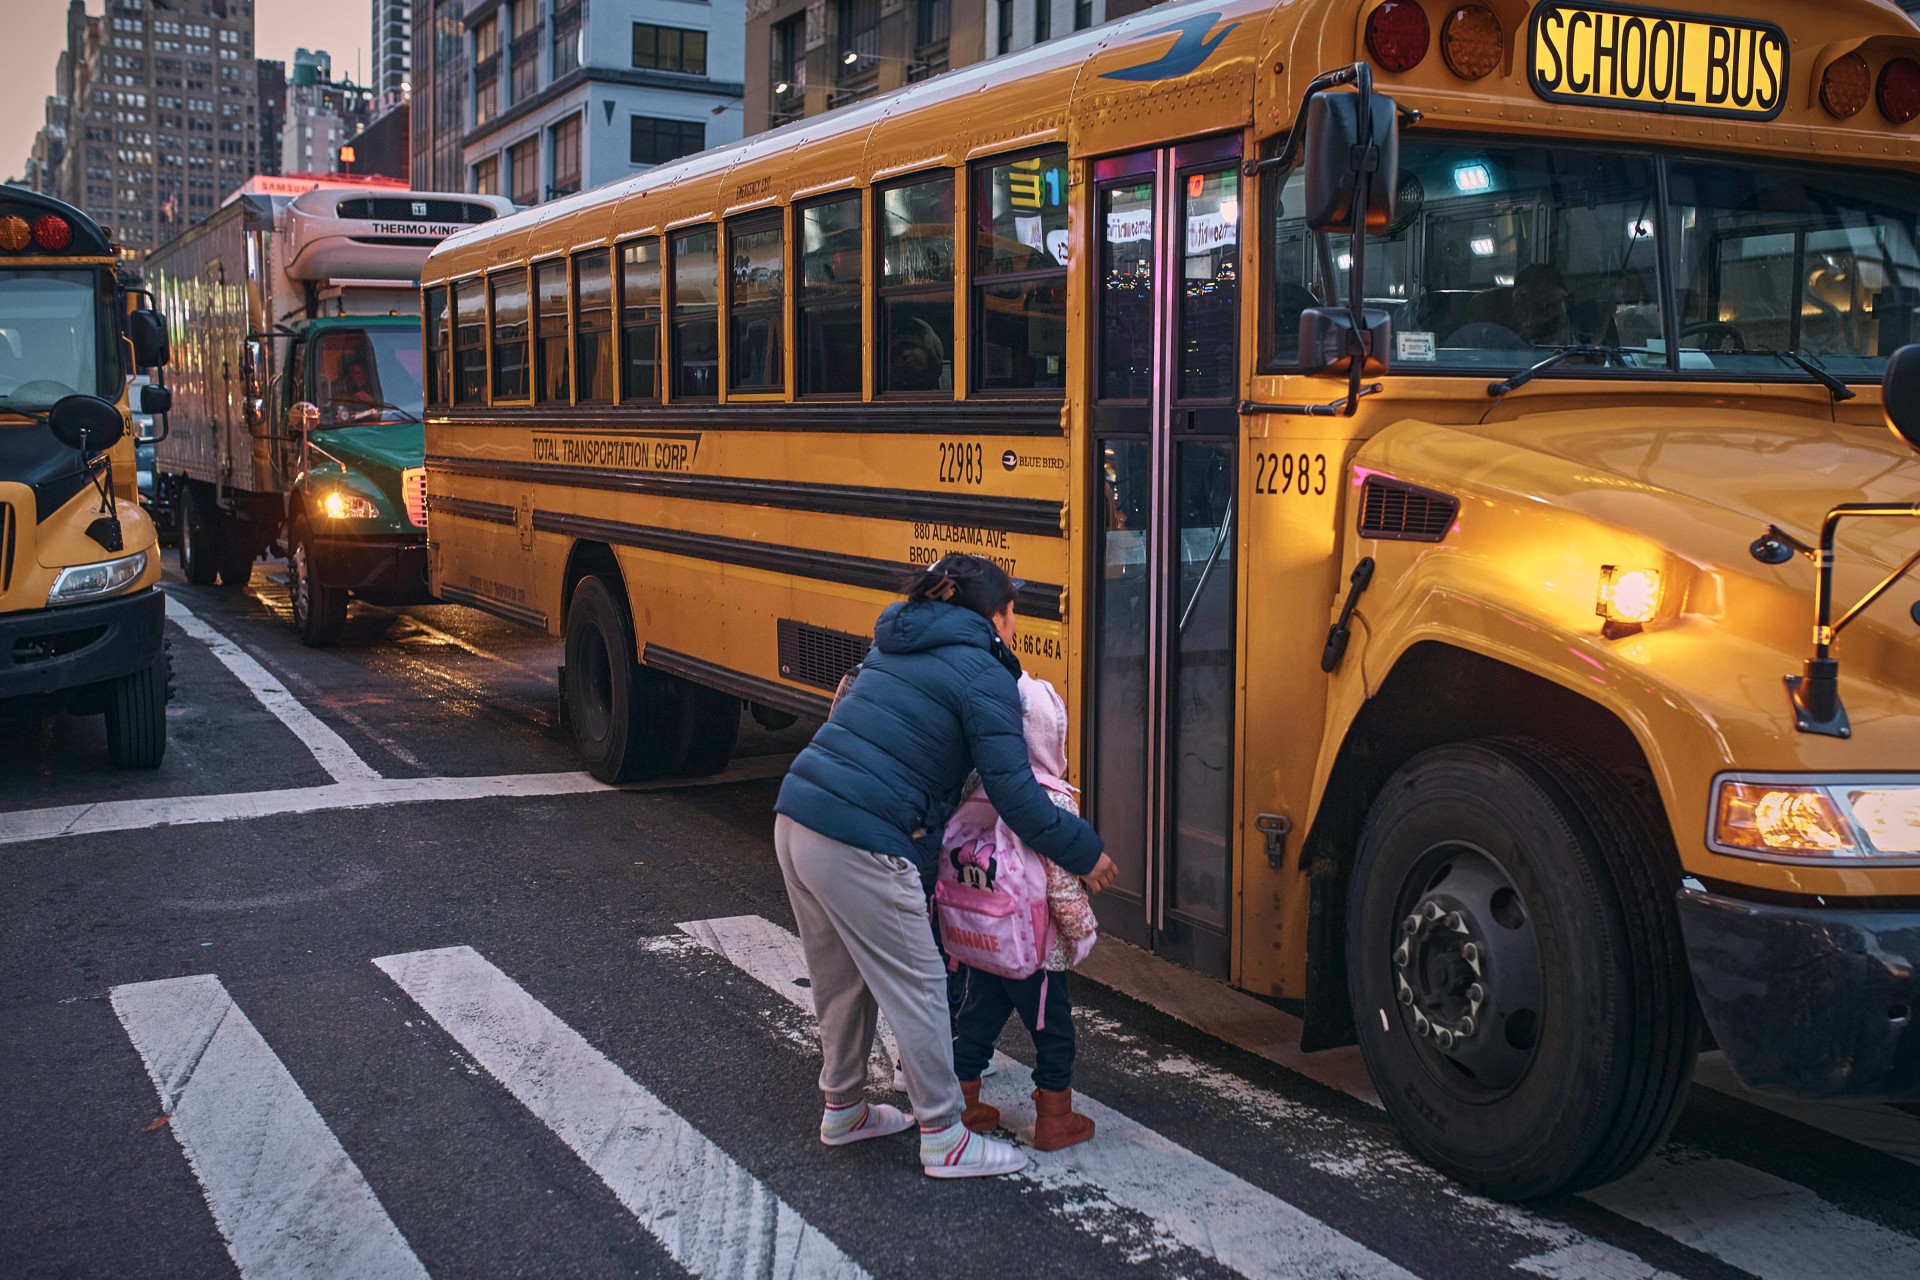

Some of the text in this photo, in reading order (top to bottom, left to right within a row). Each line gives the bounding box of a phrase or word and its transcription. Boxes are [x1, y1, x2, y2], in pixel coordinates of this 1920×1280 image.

[1537, 8, 1780, 109] SCHOOL BUS
[372, 222, 459, 236] THERMO KING
[532, 437, 690, 471] TOTAL TRANSPORTATION CORP.
[939, 442, 983, 485] 22983
[1018, 456, 1065, 469] BLUE BIRD
[1255, 452, 1327, 496] 22983
[914, 523, 1010, 550] 880 ALABAMA AVE.
